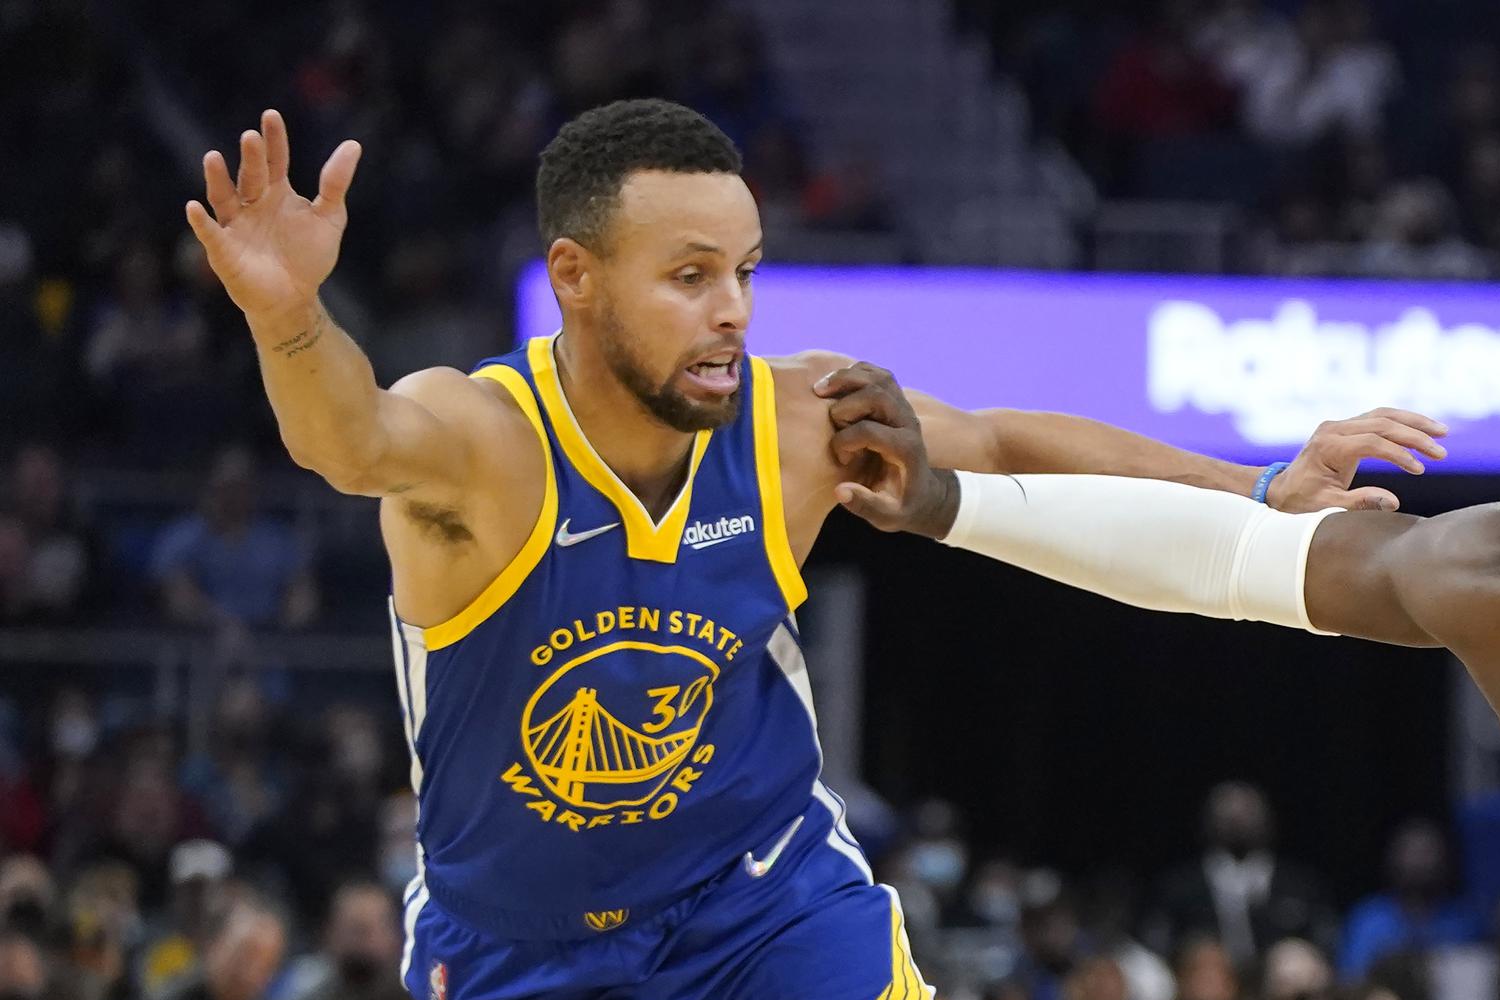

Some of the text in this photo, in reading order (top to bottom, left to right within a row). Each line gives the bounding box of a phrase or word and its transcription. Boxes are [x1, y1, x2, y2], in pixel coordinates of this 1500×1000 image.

[682, 515, 755, 545] akuten
[530, 607, 744, 666] GOLDEN STATE
[642, 675, 709, 733] 30
[501, 744, 715, 832] WARRIORS
